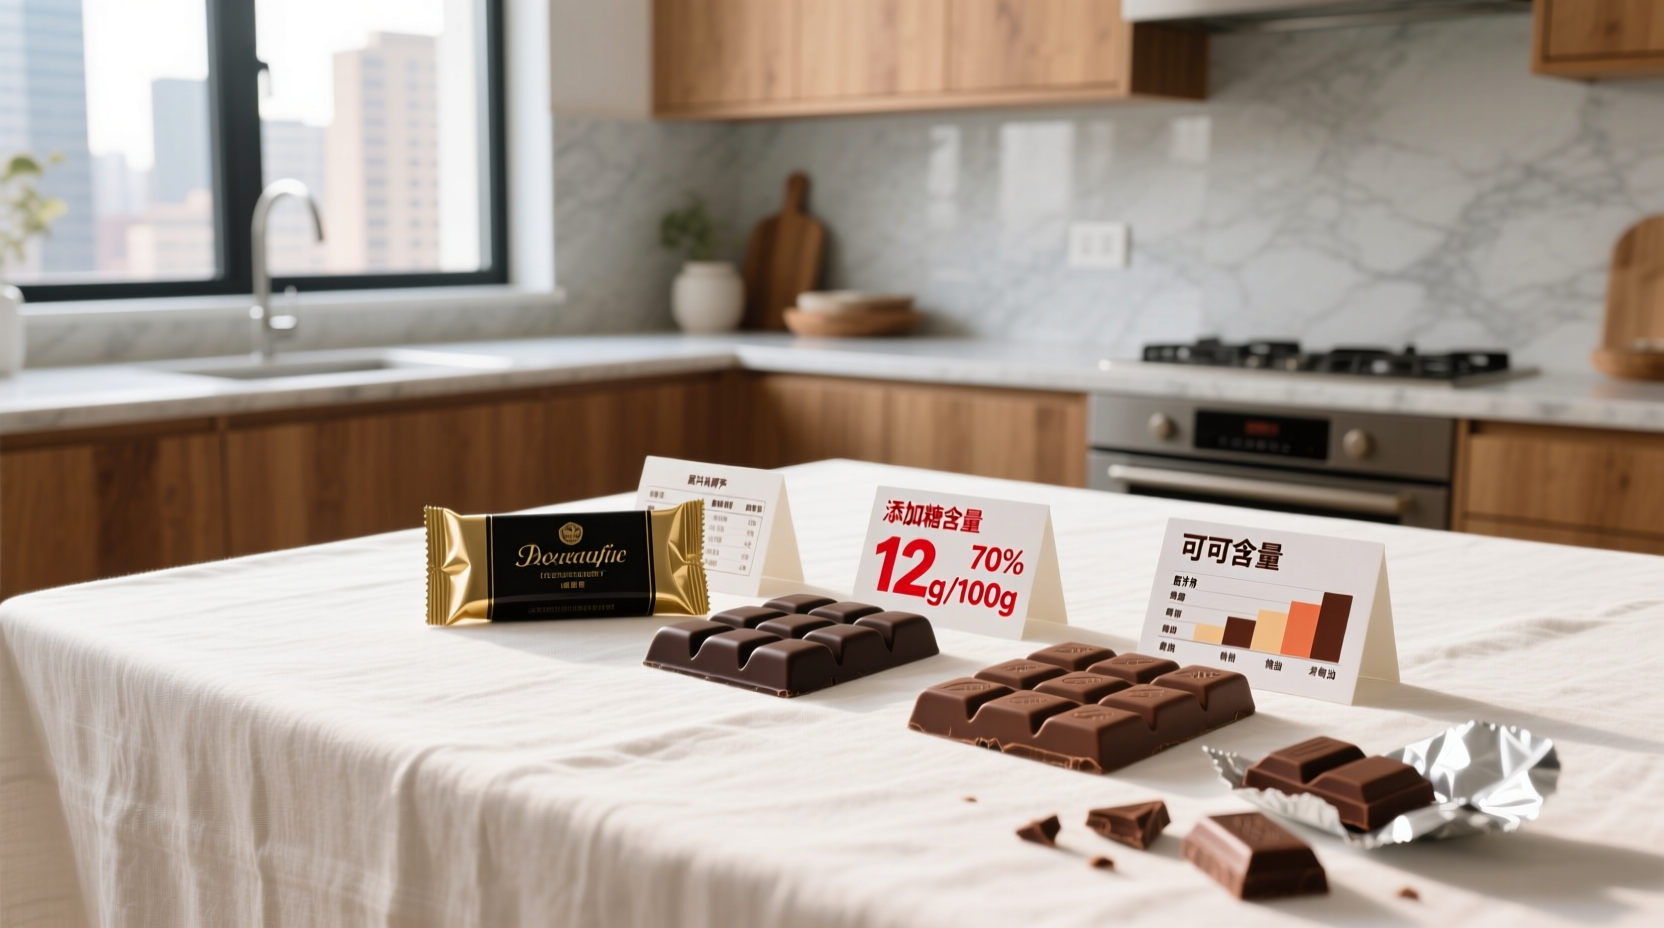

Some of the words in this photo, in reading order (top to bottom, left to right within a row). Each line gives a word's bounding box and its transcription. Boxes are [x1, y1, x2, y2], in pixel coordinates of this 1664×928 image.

[883, 499, 983, 533] 添加糖含量
[970, 544, 1024, 575] 70%
[1182, 533, 1283, 571] 可可含量
